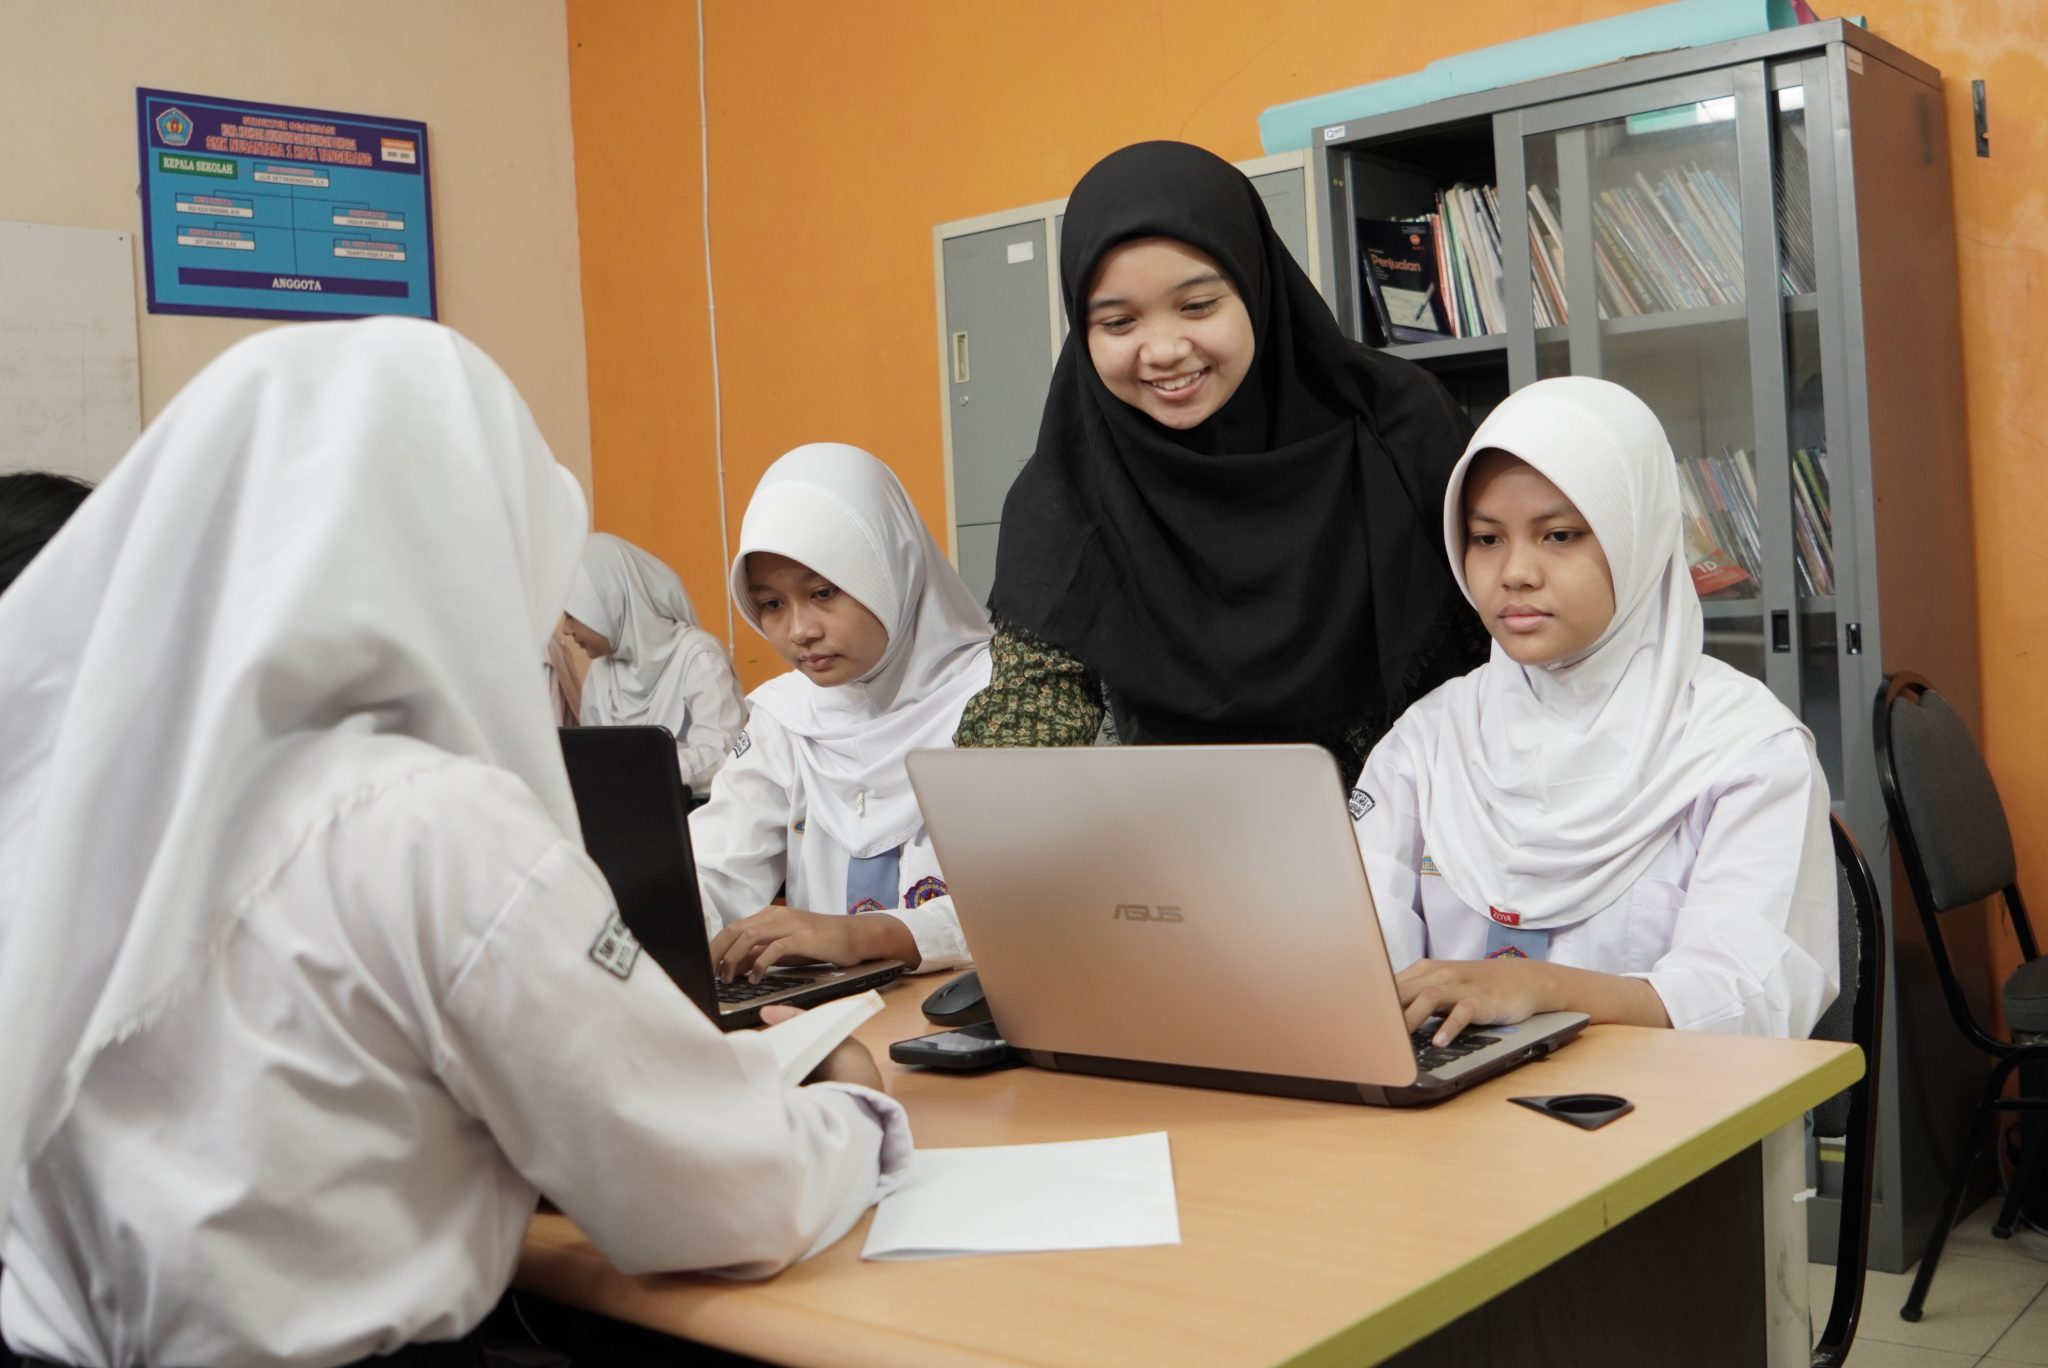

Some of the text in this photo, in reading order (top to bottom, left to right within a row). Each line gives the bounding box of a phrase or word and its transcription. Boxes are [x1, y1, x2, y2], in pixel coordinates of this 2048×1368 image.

[206, 136, 228, 152] SMK
[229, 138, 285, 158] NUSANTARA
[293, 145, 318, 161] KOTA
[318, 149, 373, 167] TANGERANG
[163, 157, 233, 174] KEPALA SEKOLAH
[1370, 253, 1422, 272] Penjualan
[272, 277, 322, 290] ANGGOTA
[1112, 903, 1185, 924] ASUS
[1492, 909, 1513, 923] ZOYA
